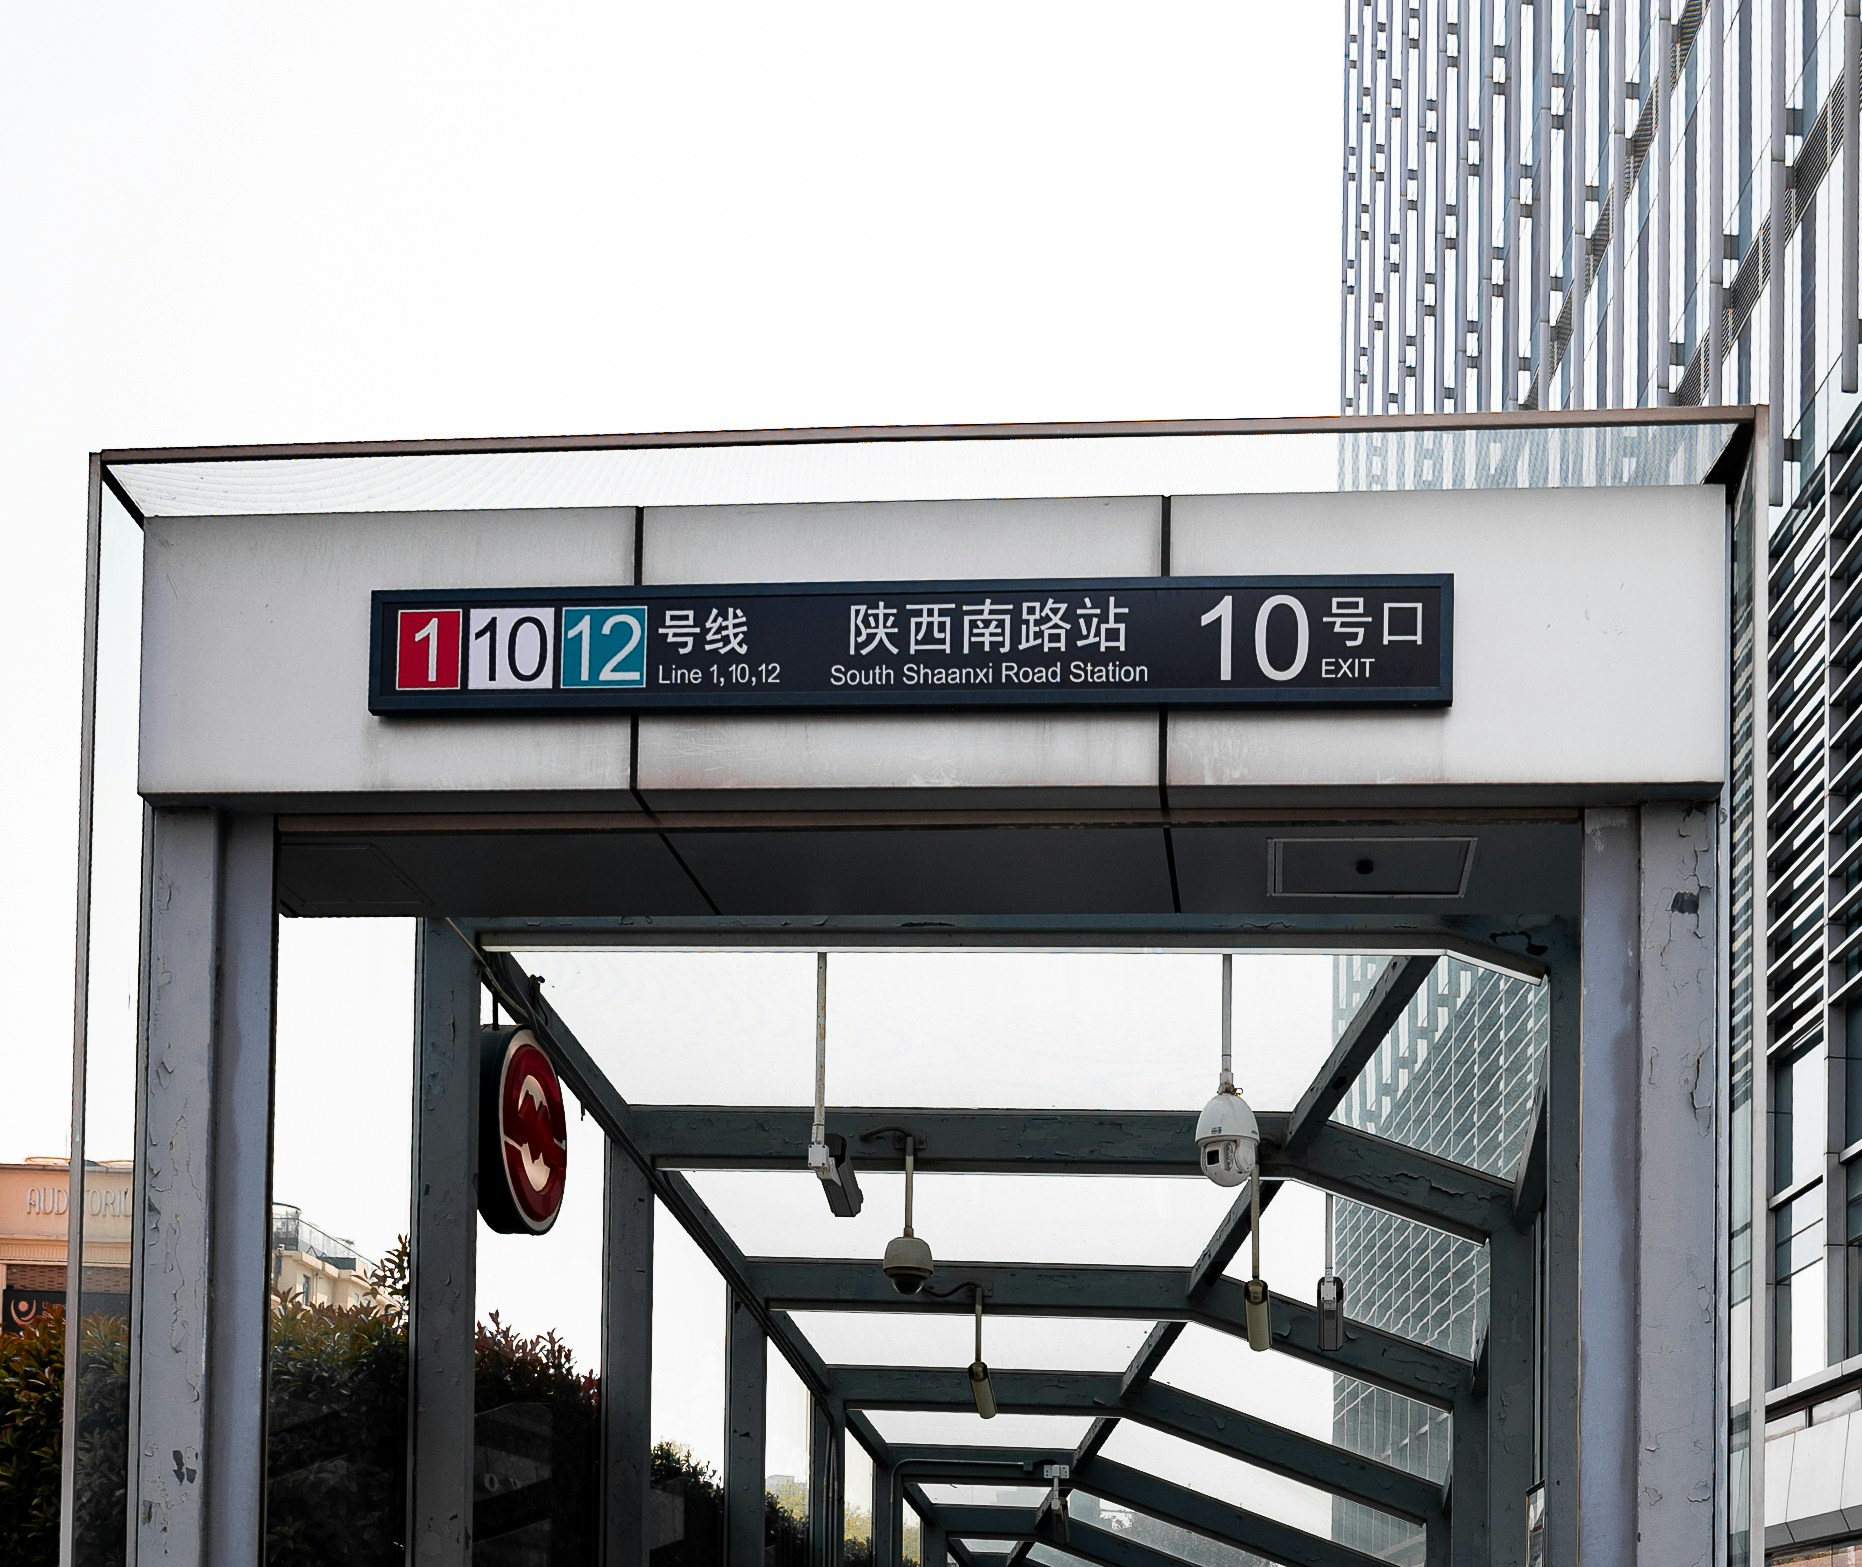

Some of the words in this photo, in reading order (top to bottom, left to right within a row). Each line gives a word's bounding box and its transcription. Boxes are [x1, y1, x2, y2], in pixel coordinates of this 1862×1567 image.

[413, 616, 440, 683] 1
[473, 615, 549, 684] 10
[566, 613, 643, 682] 12
[657, 607, 748, 656] 号线
[848, 596, 1130, 656] 陕西南路站
[1200, 594, 1310, 682] 10
[1322, 597, 1424, 649] 号口
[657, 664, 702, 685] Line
[829, 661, 896, 686] South
[902, 661, 993, 686] Shaanxi
[1001, 660, 1064, 685] Road
[1069, 659, 1149, 684] Station
[1320, 657, 1376, 679] EXIT
